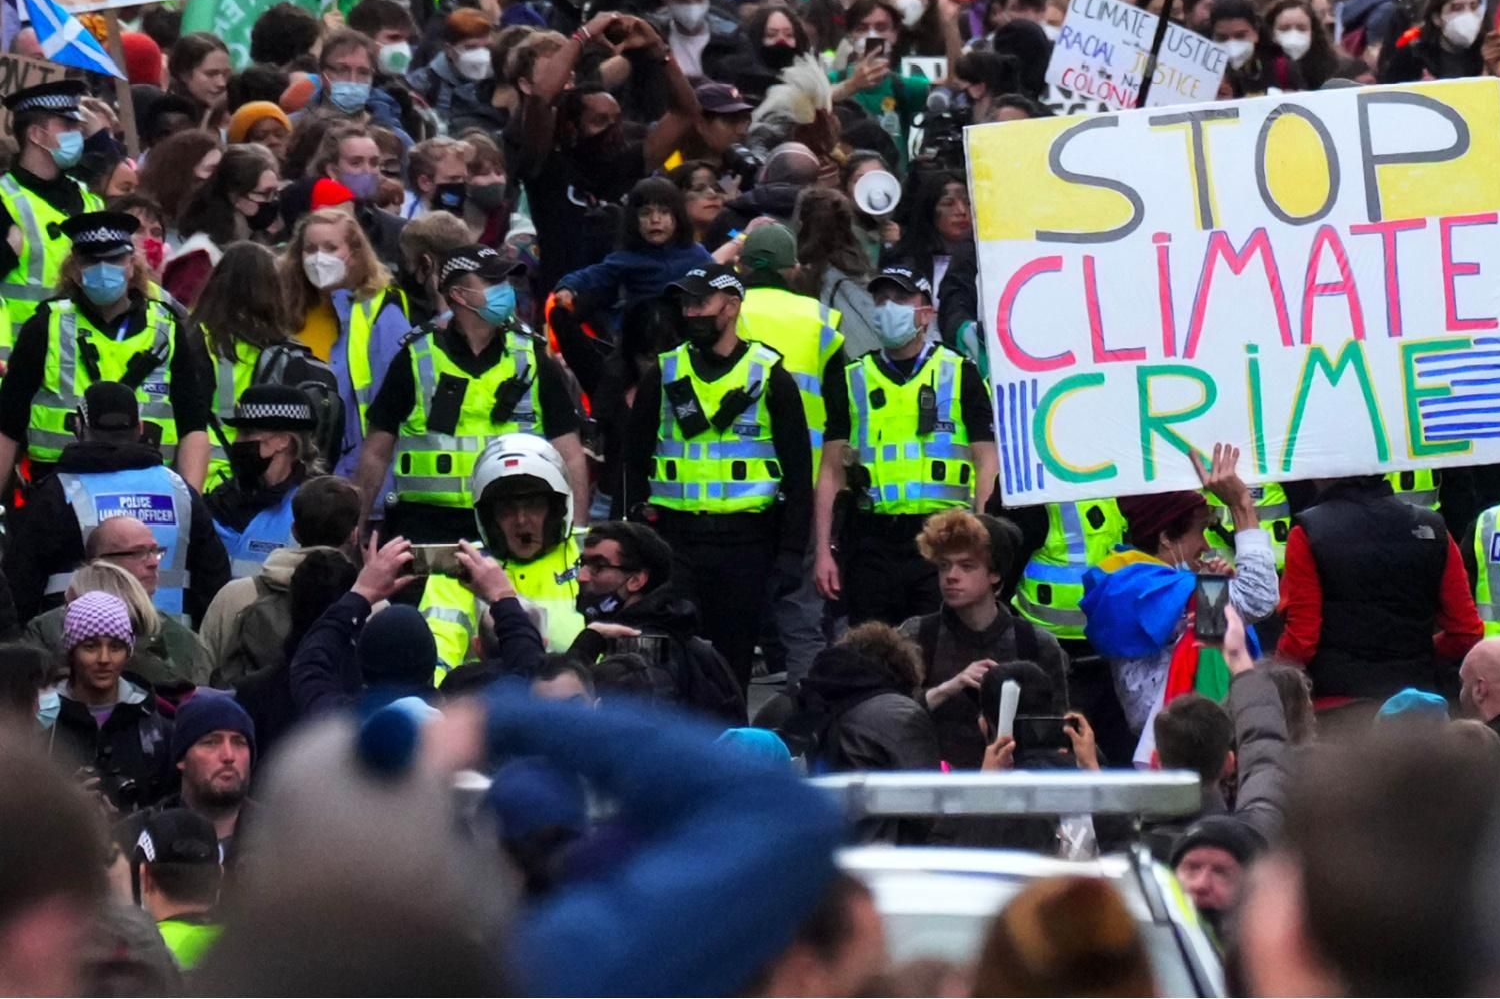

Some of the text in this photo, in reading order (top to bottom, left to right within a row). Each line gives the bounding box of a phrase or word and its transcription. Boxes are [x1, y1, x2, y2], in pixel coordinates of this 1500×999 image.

[1059, 25, 1114, 66] RACIAL
[1165, 25, 1227, 74] JUSTICE
[1035, 90, 1470, 244] STOP
[118, 495, 153, 509] POLICE
[138, 507, 174, 522] OFFICER
